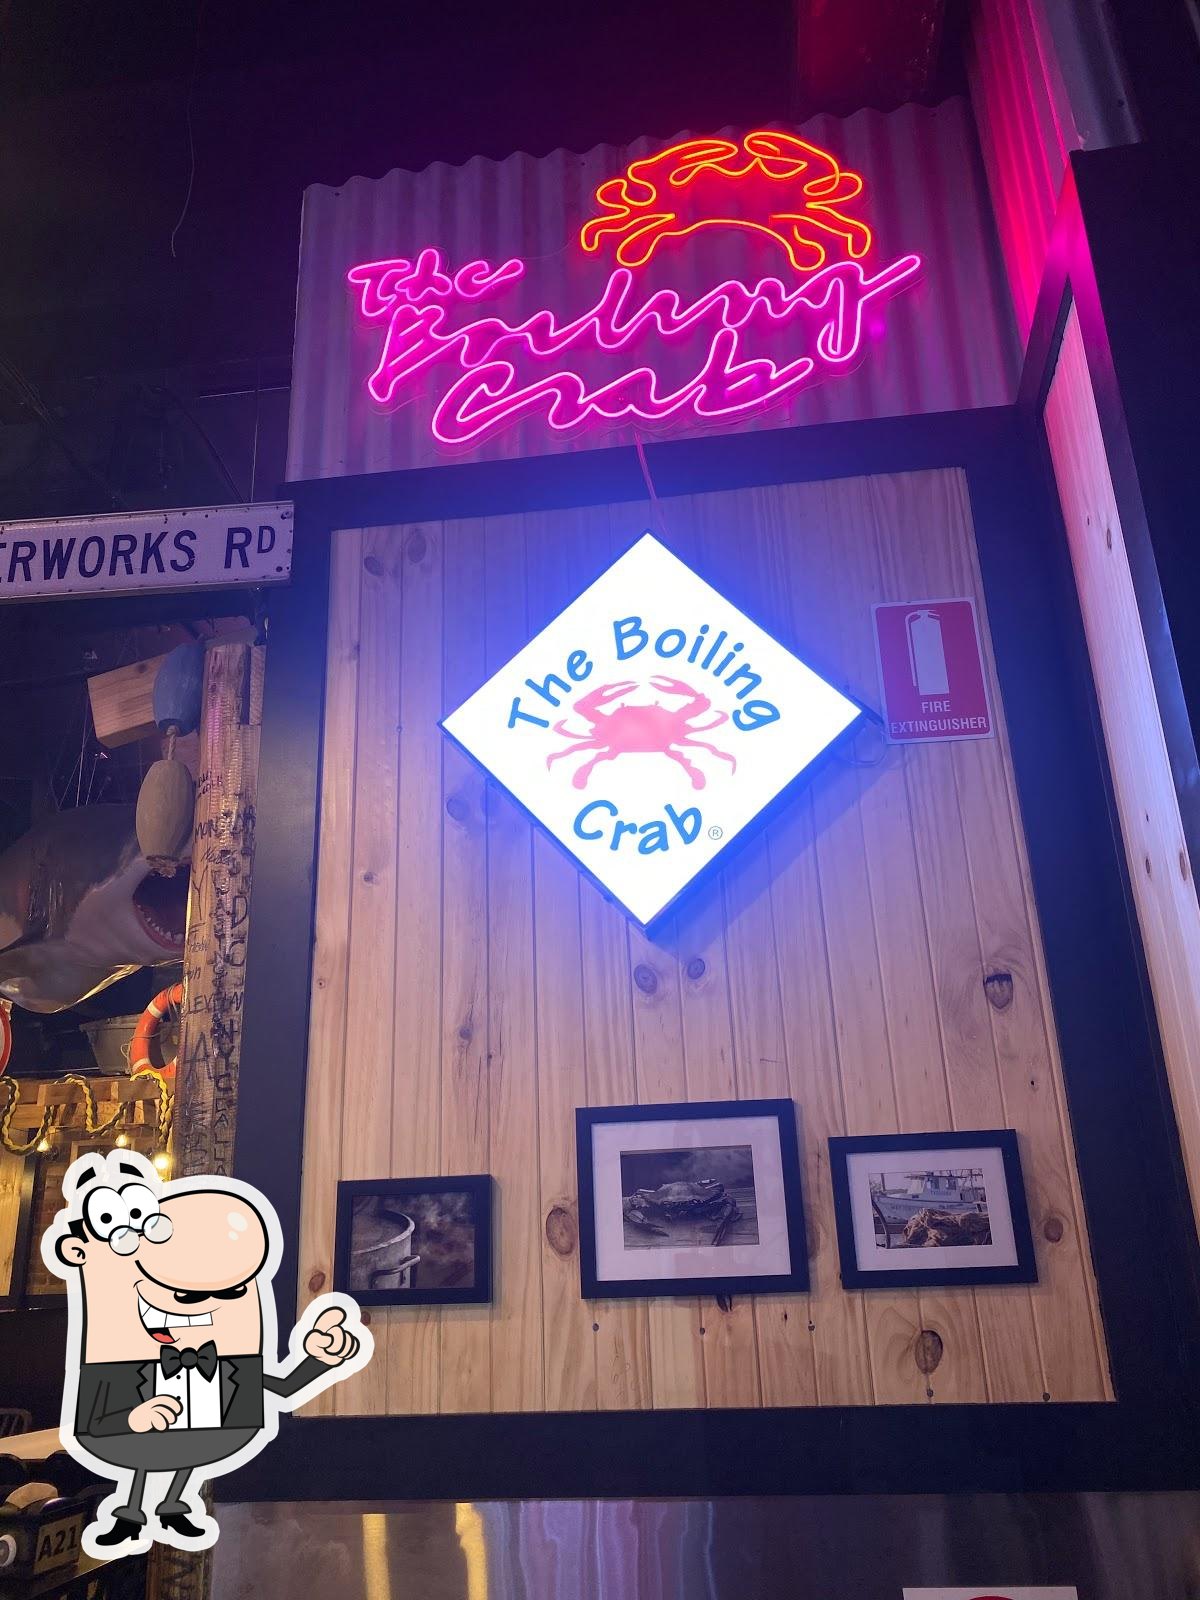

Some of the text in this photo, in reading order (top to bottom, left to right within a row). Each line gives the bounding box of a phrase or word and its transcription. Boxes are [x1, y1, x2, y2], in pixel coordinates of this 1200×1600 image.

[347, 247, 524, 317] The
[367, 254, 921, 403] Boiling
[432, 328, 815, 444] Crab
[0, 529, 197, 583] RWORKS
[507, 616, 781, 731] The Boiling
[891, 716, 988, 734] EXTINGUISHER
[921, 700, 952, 714] FIRE
[573, 799, 702, 855] Crab
[37, 1525, 78, 1562] A21
